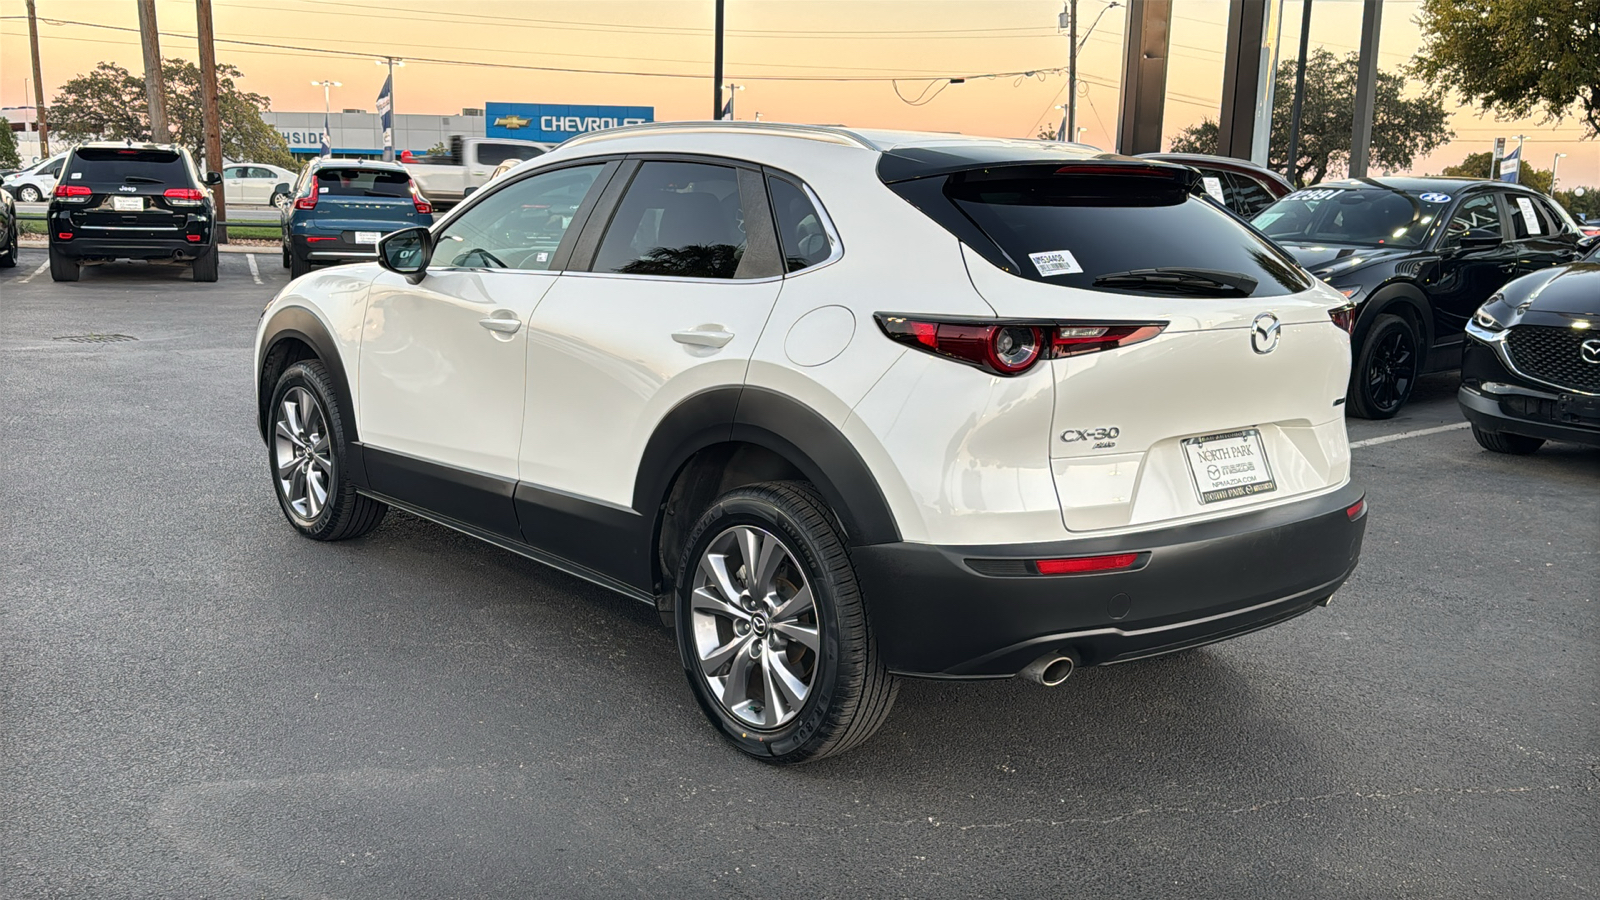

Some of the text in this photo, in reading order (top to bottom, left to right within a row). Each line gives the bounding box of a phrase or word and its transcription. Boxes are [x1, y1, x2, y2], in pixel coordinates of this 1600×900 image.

[118, 185, 137, 193] Jeep
[1060, 427, 1120, 443] CX-30
[1197, 444, 1254, 463] NORTH PARK
[1212, 475, 1257, 488] NPMAZDA.COM
[1204, 489, 1227, 502] NORTH
[1227, 485, 1246, 498] PARK
